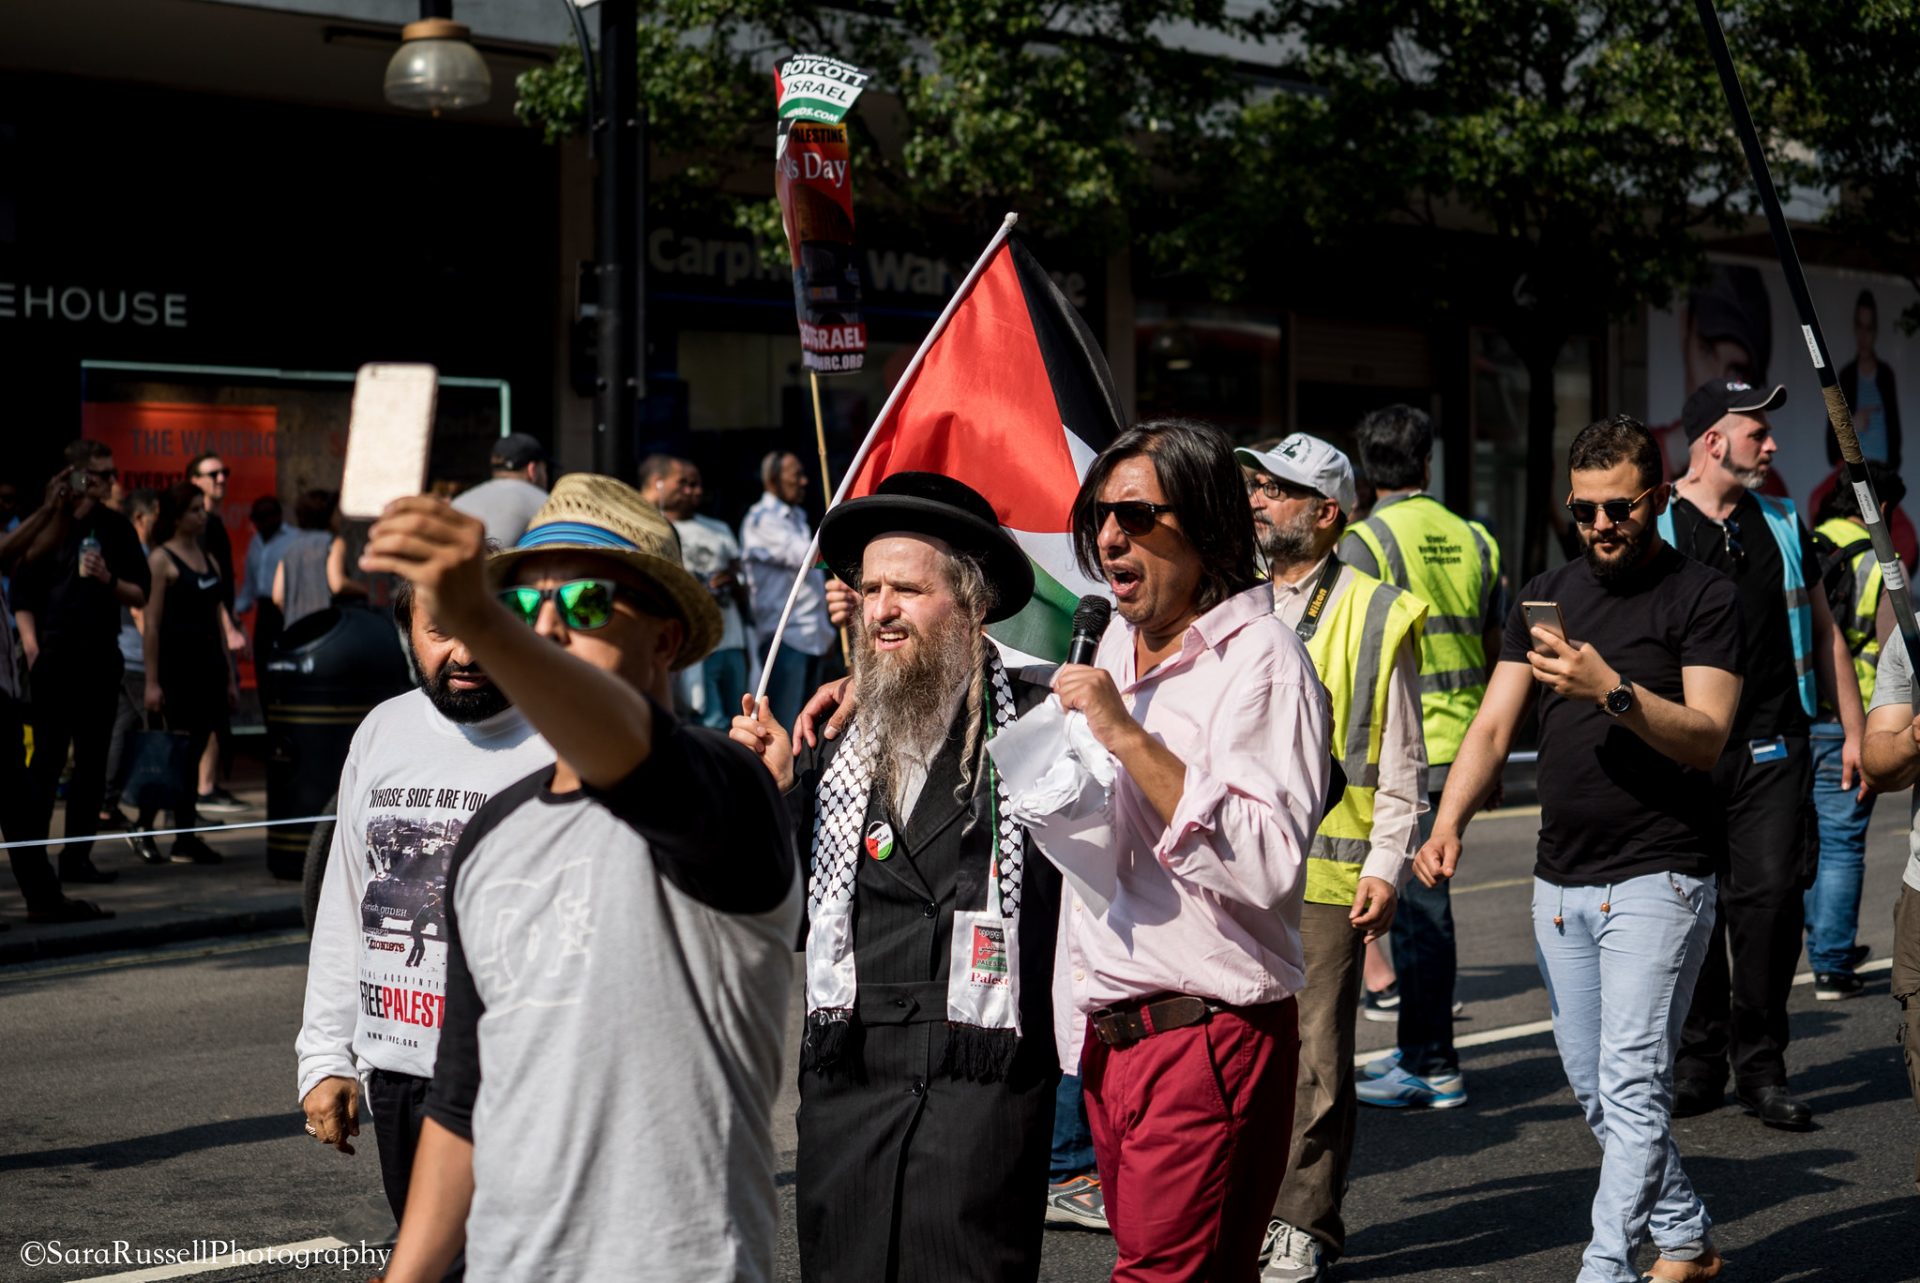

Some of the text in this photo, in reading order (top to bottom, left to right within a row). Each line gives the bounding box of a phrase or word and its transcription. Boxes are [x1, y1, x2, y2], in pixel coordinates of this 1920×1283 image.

[780, 60, 869, 87] BOYCOTT
[787, 80, 848, 103] ISRAEL
[803, 152, 848, 188] Day
[0, 283, 188, 328] EHOUSE
[131, 430, 280, 458] THE WAREHO
[1307, 588, 1328, 618] Nikon
[369, 787, 488, 812] WHOSE SIDE ARE YOU
[971, 972, 1009, 986] Palest
